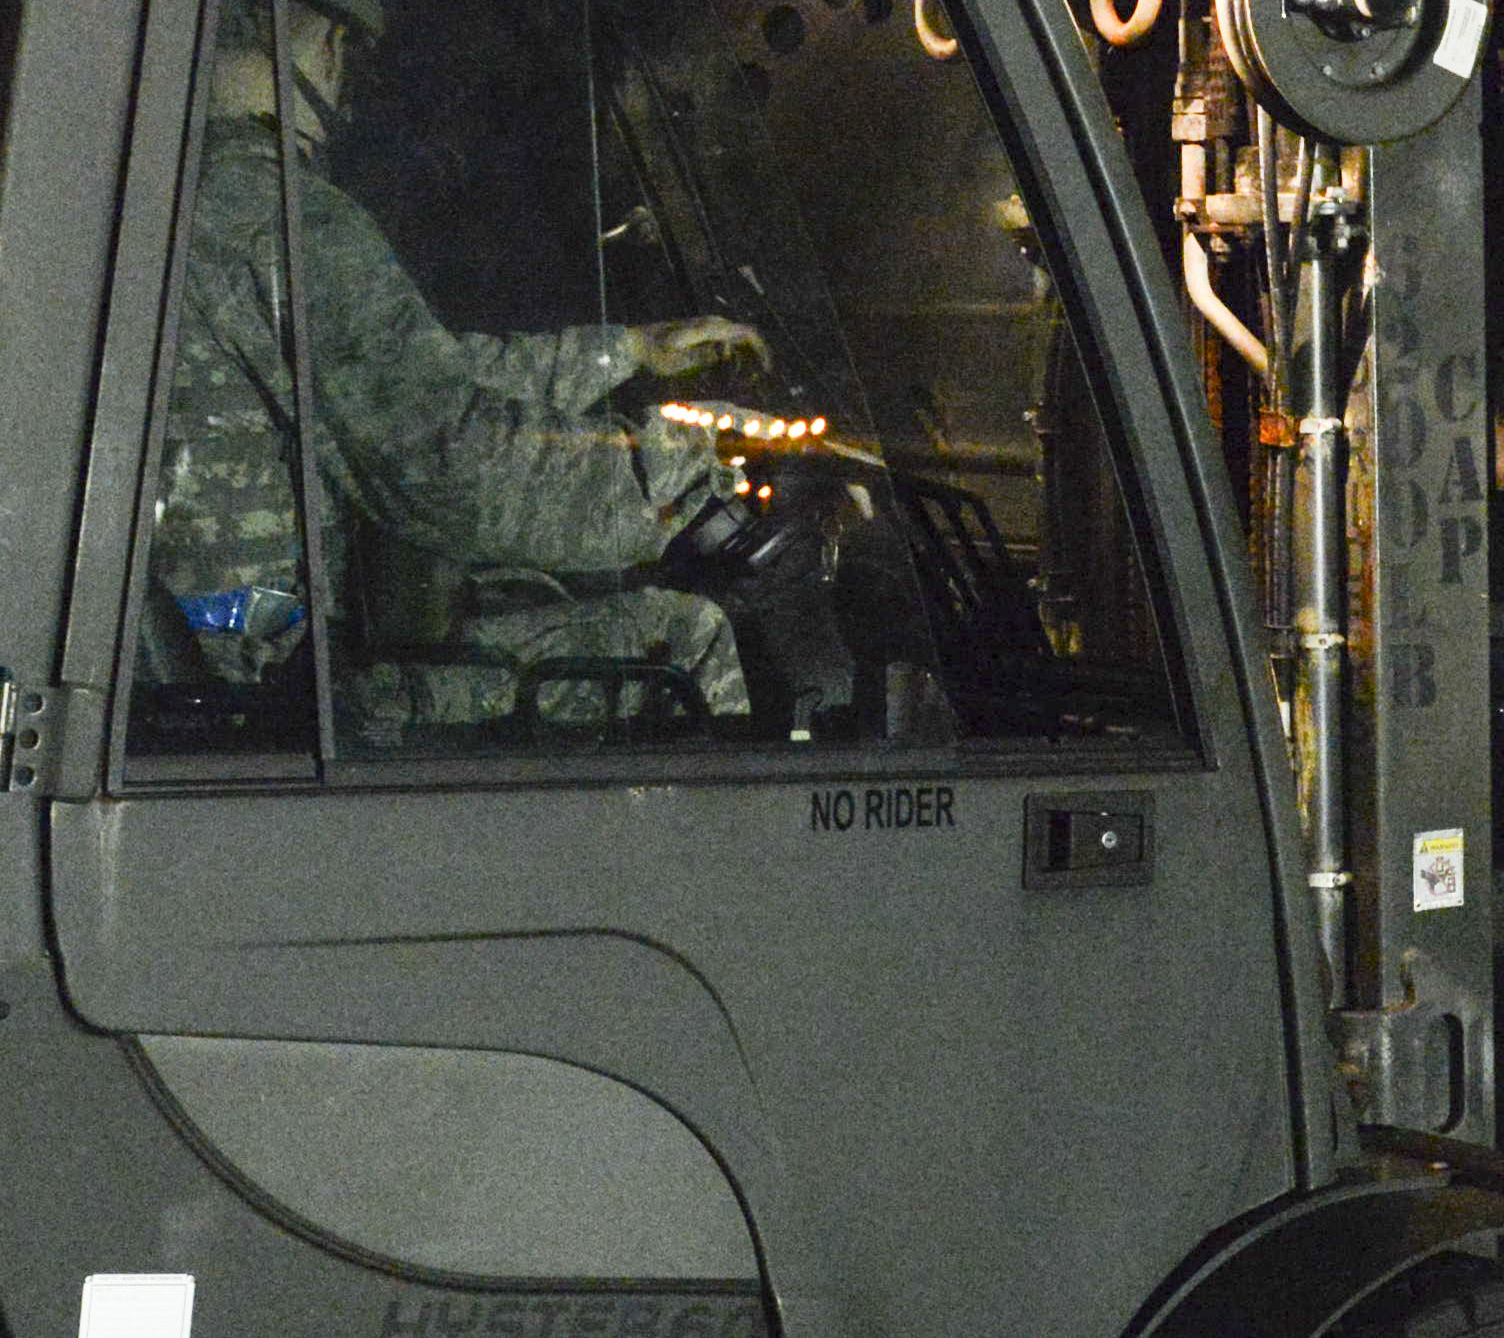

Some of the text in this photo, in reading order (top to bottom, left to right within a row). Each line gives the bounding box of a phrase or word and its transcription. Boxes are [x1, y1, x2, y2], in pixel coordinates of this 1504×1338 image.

[1435, 355, 1483, 585] CAP
[811, 786, 955, 831] NO RIDER
